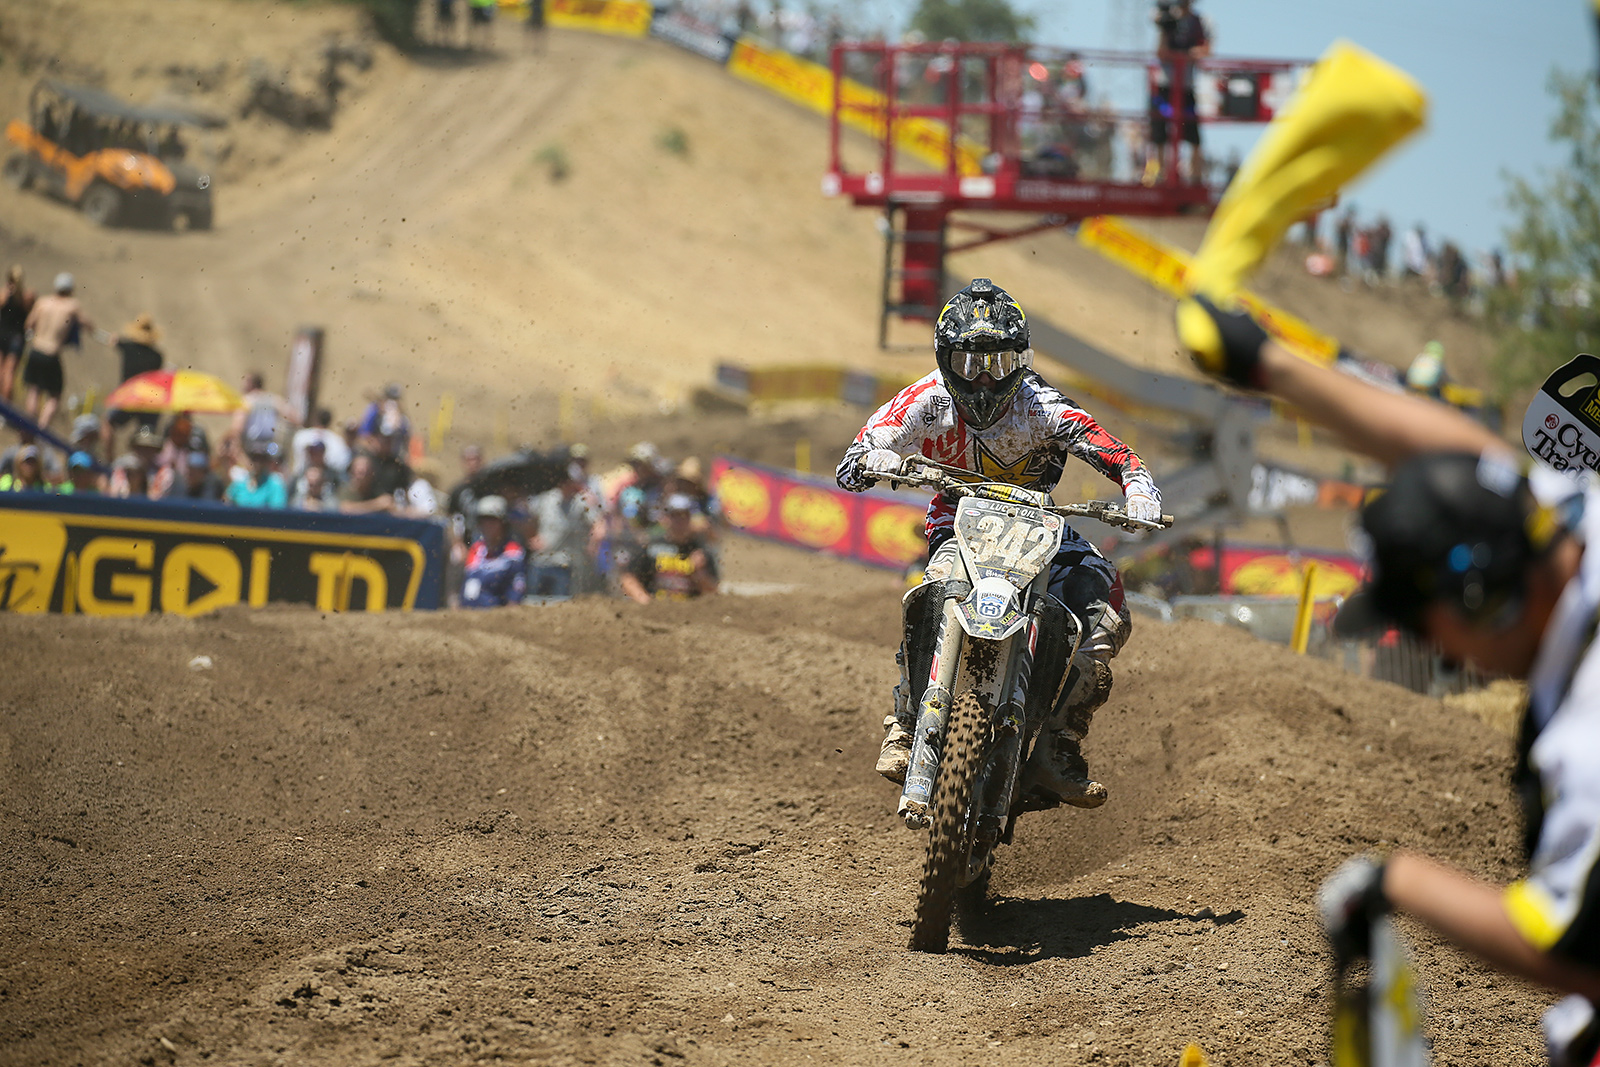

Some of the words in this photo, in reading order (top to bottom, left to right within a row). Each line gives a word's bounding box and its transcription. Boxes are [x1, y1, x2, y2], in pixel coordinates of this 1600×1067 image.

[990, 503, 1020, 516] LUCS
[1021, 508, 1036, 519] OIL
[968, 515, 1055, 577] 342
